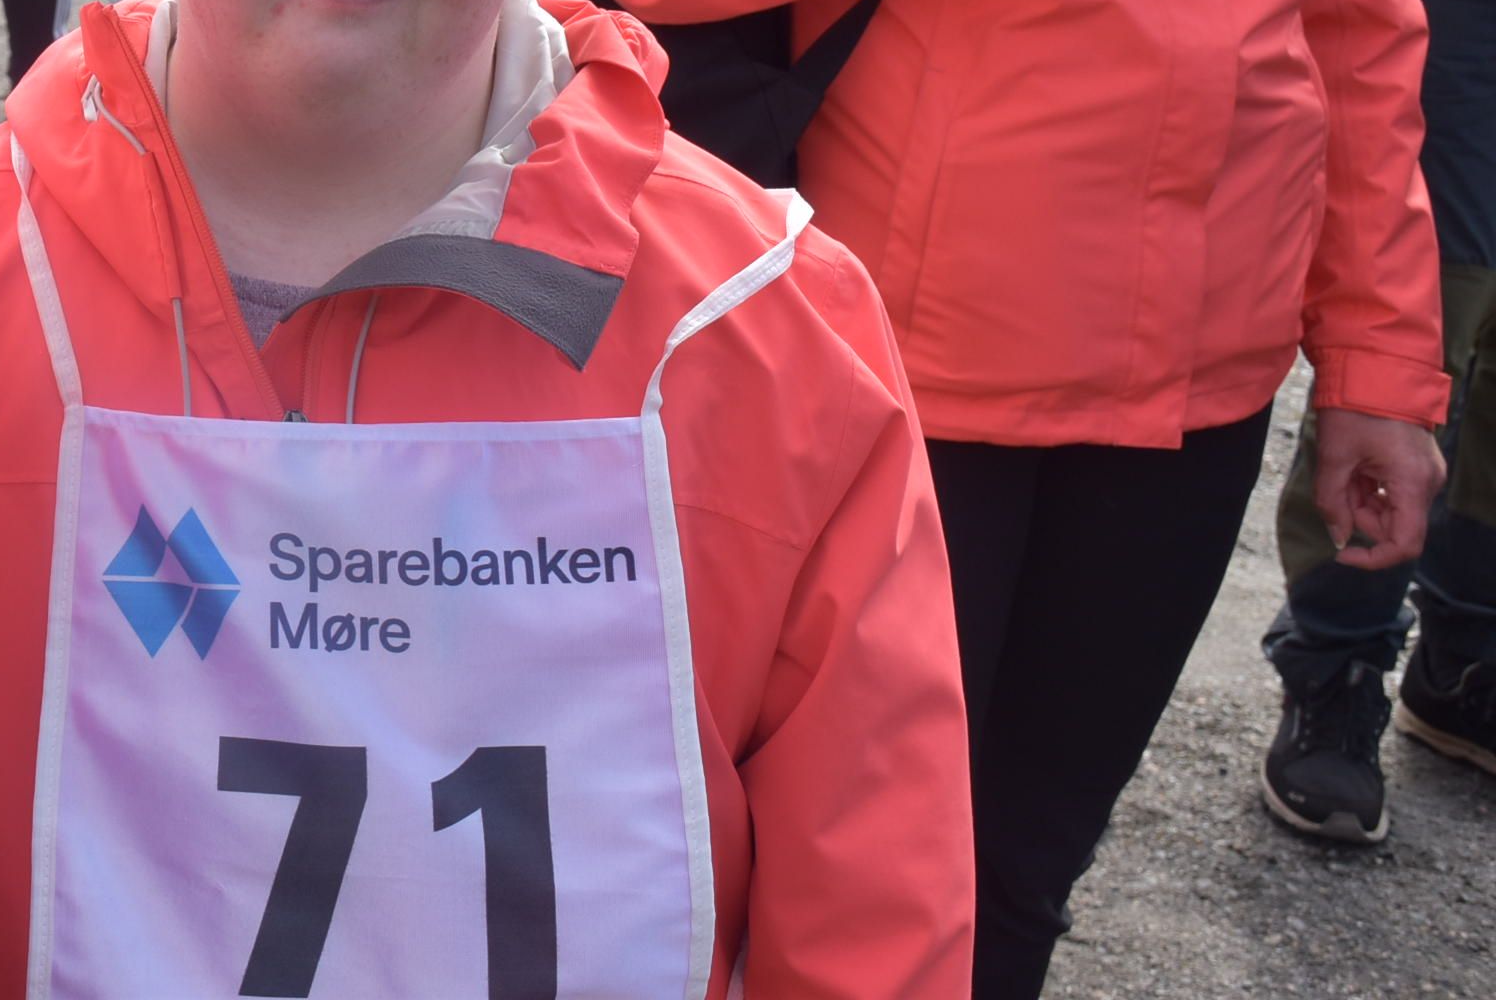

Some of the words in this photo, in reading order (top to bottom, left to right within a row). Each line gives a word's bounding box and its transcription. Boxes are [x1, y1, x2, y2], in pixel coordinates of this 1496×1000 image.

[268, 532, 637, 593] Sparebanken
[269, 601, 411, 654] Møre
[217, 736, 558, 1000] 71
